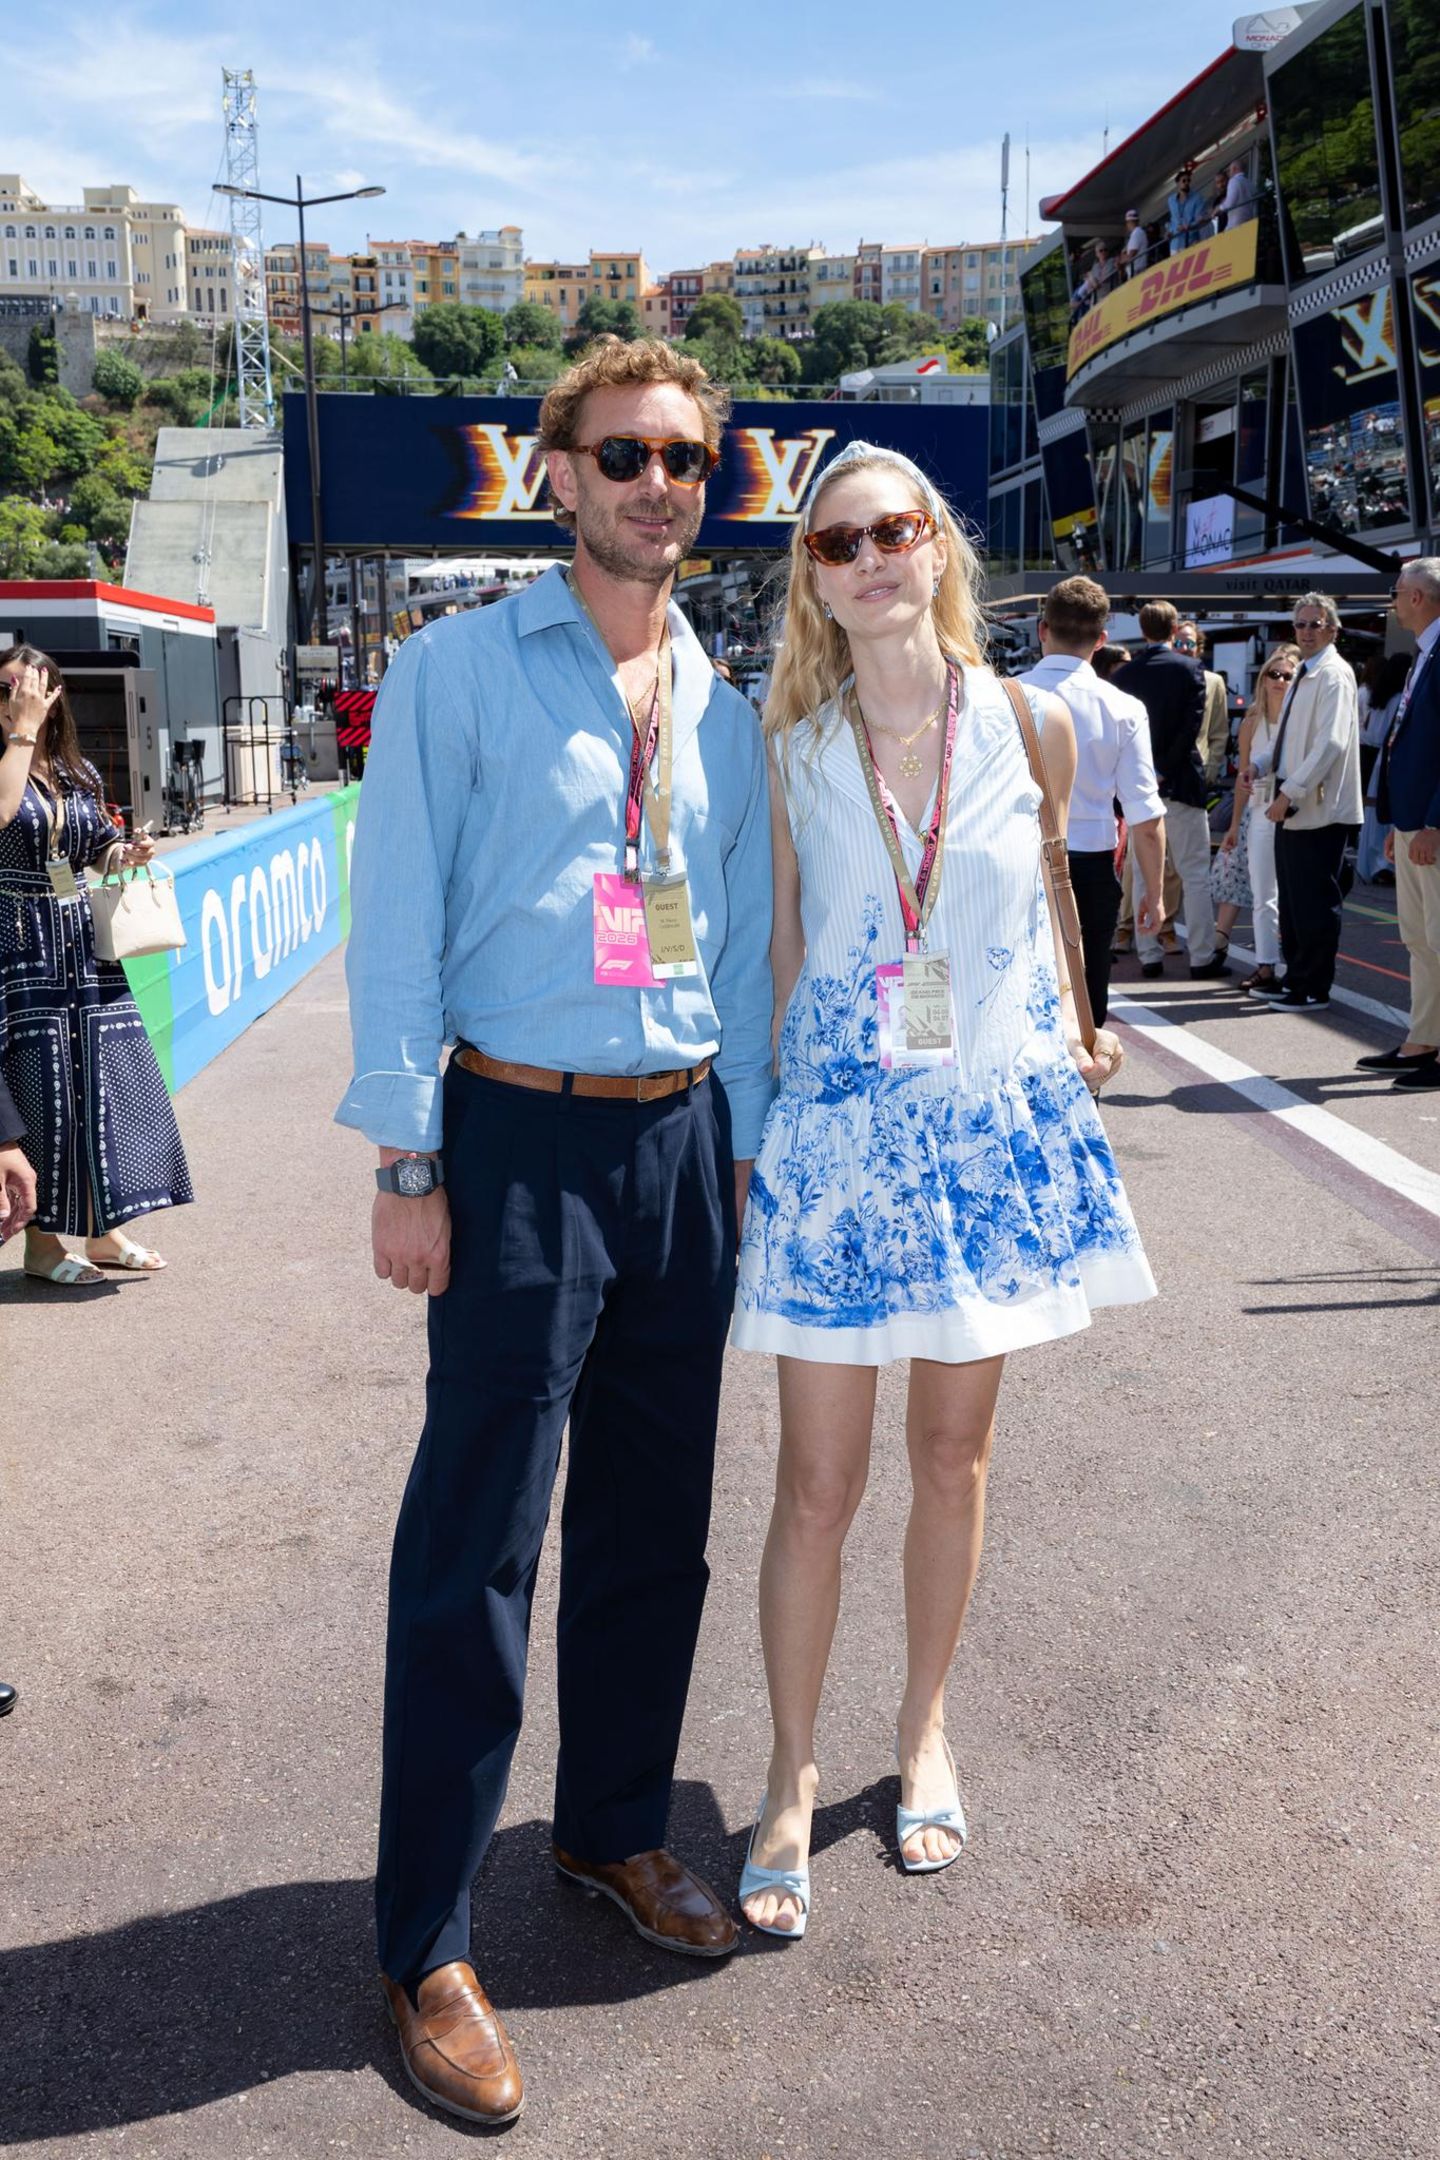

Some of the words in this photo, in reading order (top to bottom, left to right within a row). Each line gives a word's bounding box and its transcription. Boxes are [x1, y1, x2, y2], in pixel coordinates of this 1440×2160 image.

[1138, 247, 1214, 316] DHL
[1071, 308, 1104, 366] DHL
[1225, 577, 1257, 591] visit
[1263, 577, 1310, 593] QATAR
[655, 902, 679, 911] GUEST
[597, 932, 638, 945] 2026
